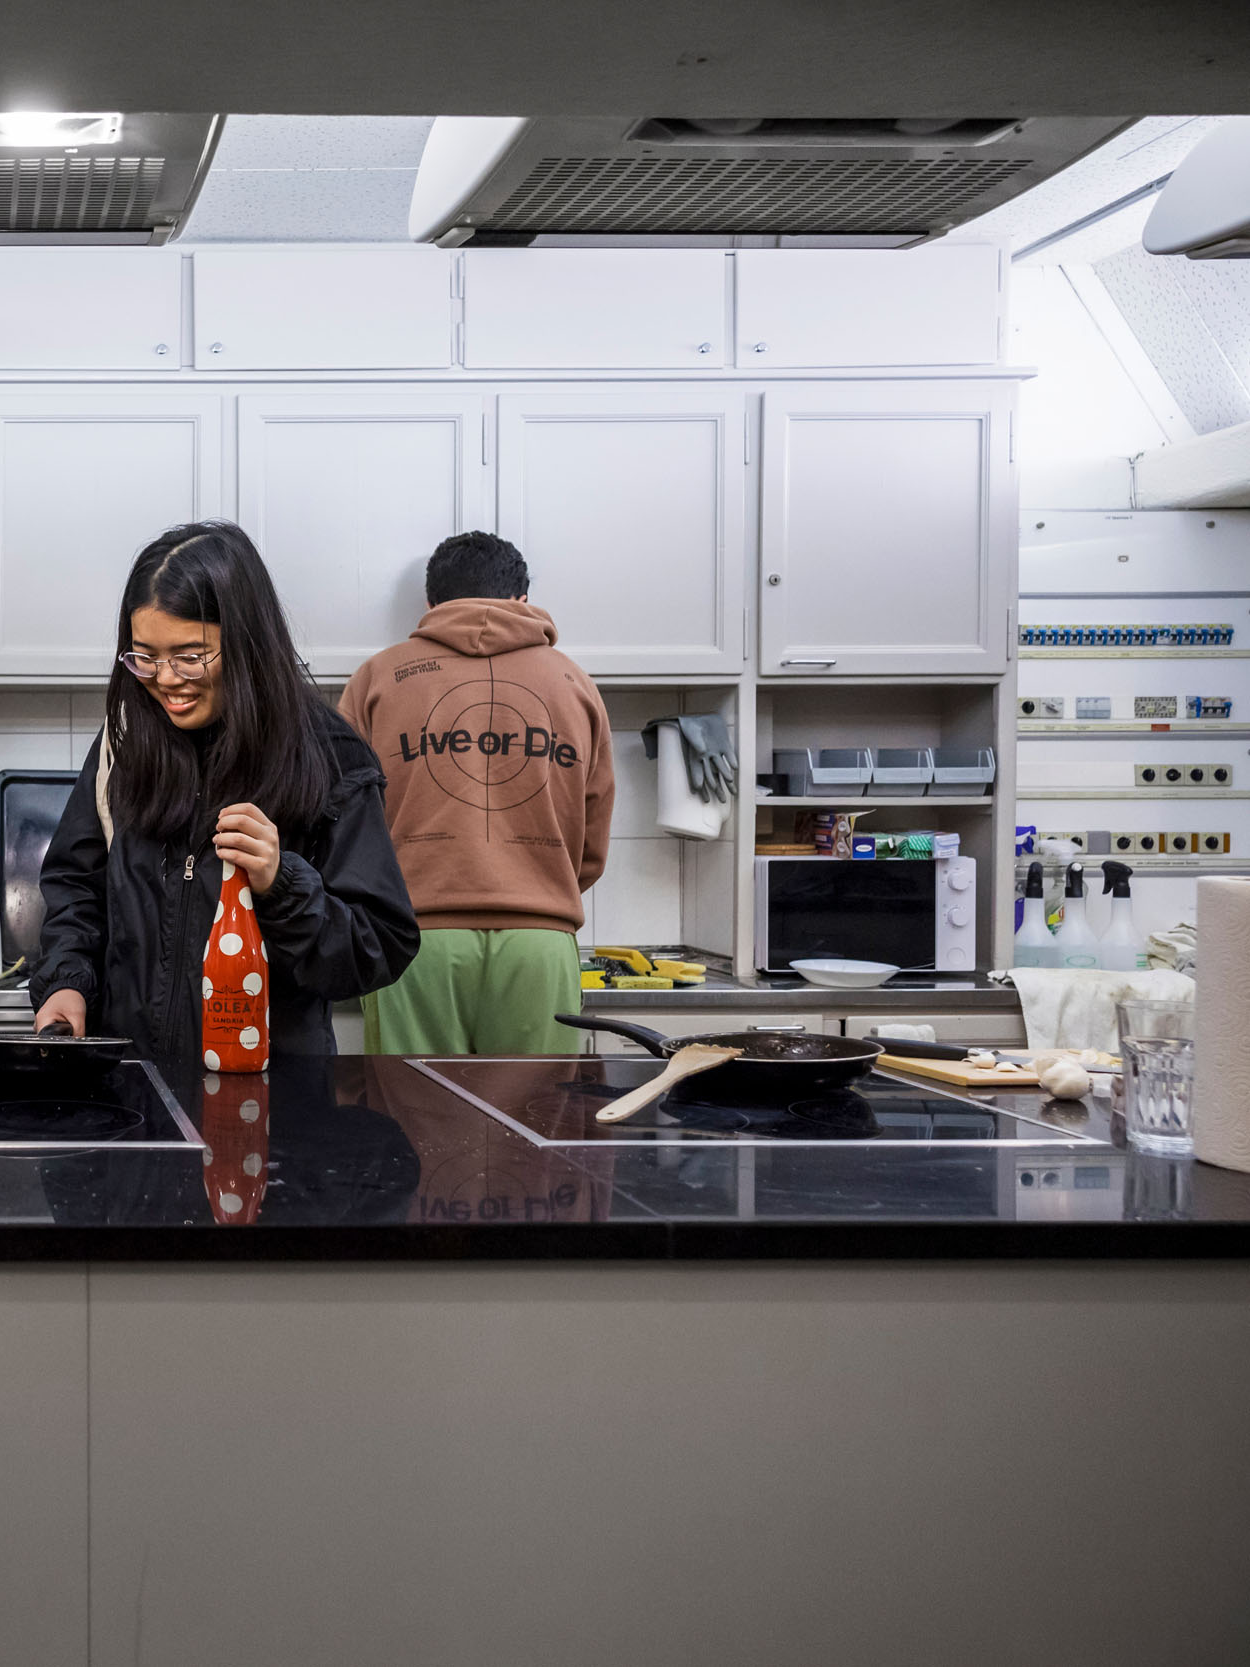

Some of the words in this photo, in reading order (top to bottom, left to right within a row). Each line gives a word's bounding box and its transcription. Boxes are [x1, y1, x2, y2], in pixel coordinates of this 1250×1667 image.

[400, 727, 473, 762] Live
[477, 731, 518, 755] or
[525, 727, 577, 768] Die
[207, 1001, 251, 1013] LOLEA
